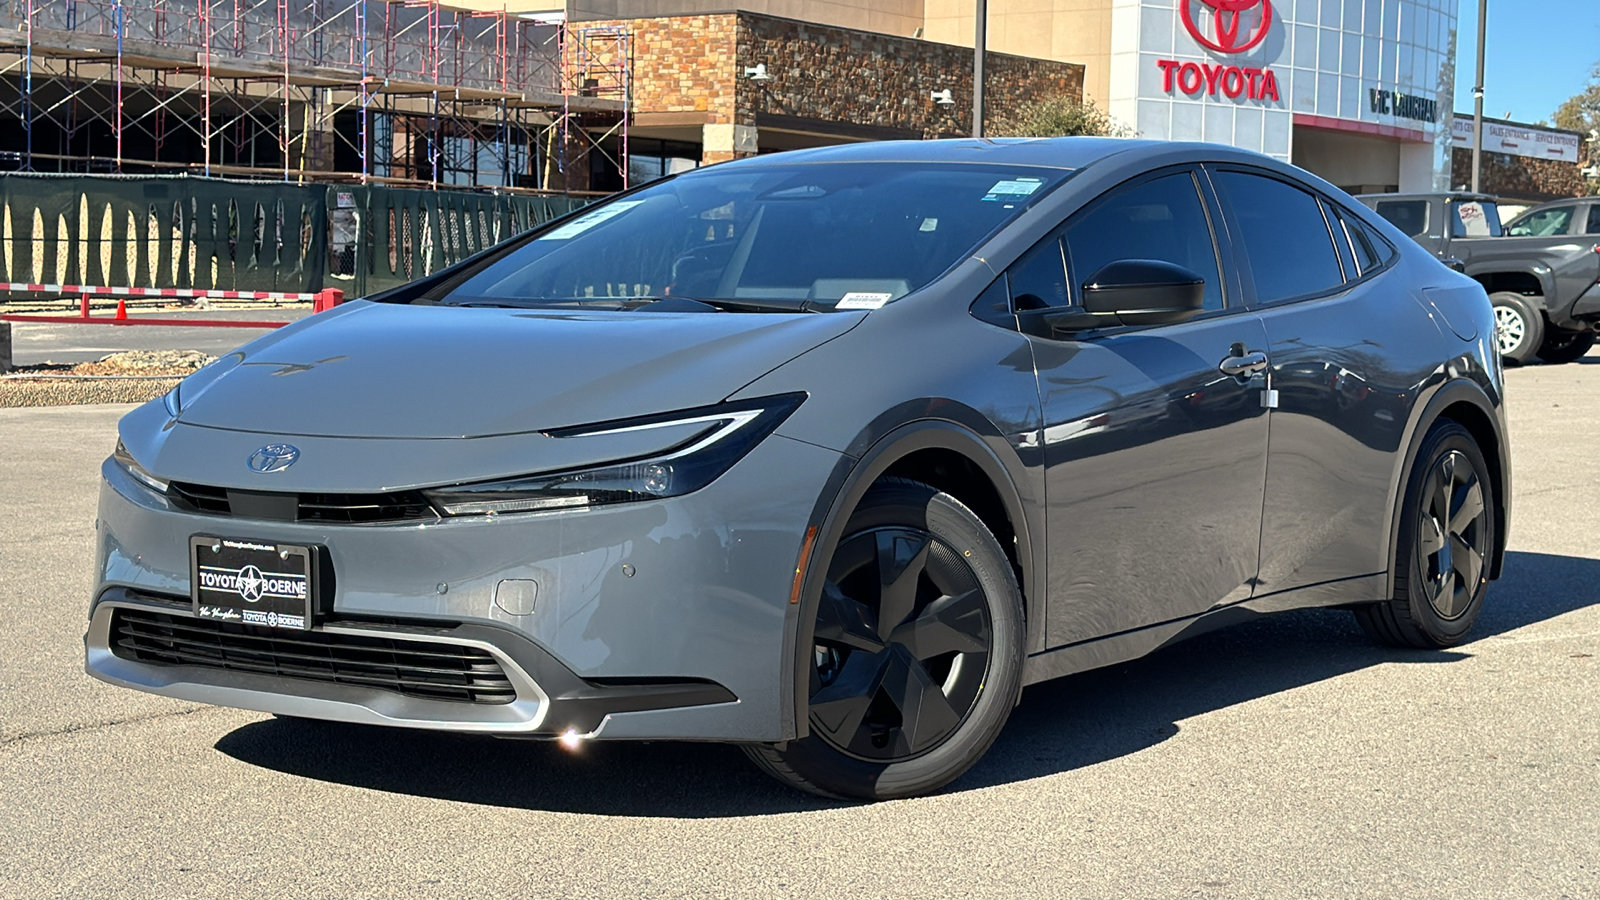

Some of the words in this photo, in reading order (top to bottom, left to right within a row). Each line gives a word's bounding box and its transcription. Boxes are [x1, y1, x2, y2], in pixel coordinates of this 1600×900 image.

[1156, 59, 1279, 102] TOYOTA
[1370, 88, 1390, 115] VIC
[1392, 92, 1437, 123] VAUGHAN
[1489, 125, 1503, 137] SALES
[1505, 128, 1529, 140] ENTRANCE
[1535, 132, 1553, 144] SERVICE
[1554, 135, 1577, 147] ENTRANCE
[199, 572, 243, 590] TOYOTA
[263, 579, 306, 595] BOERNE
[242, 612, 267, 623] TOYOTA
[278, 616, 305, 627] BOERNE
